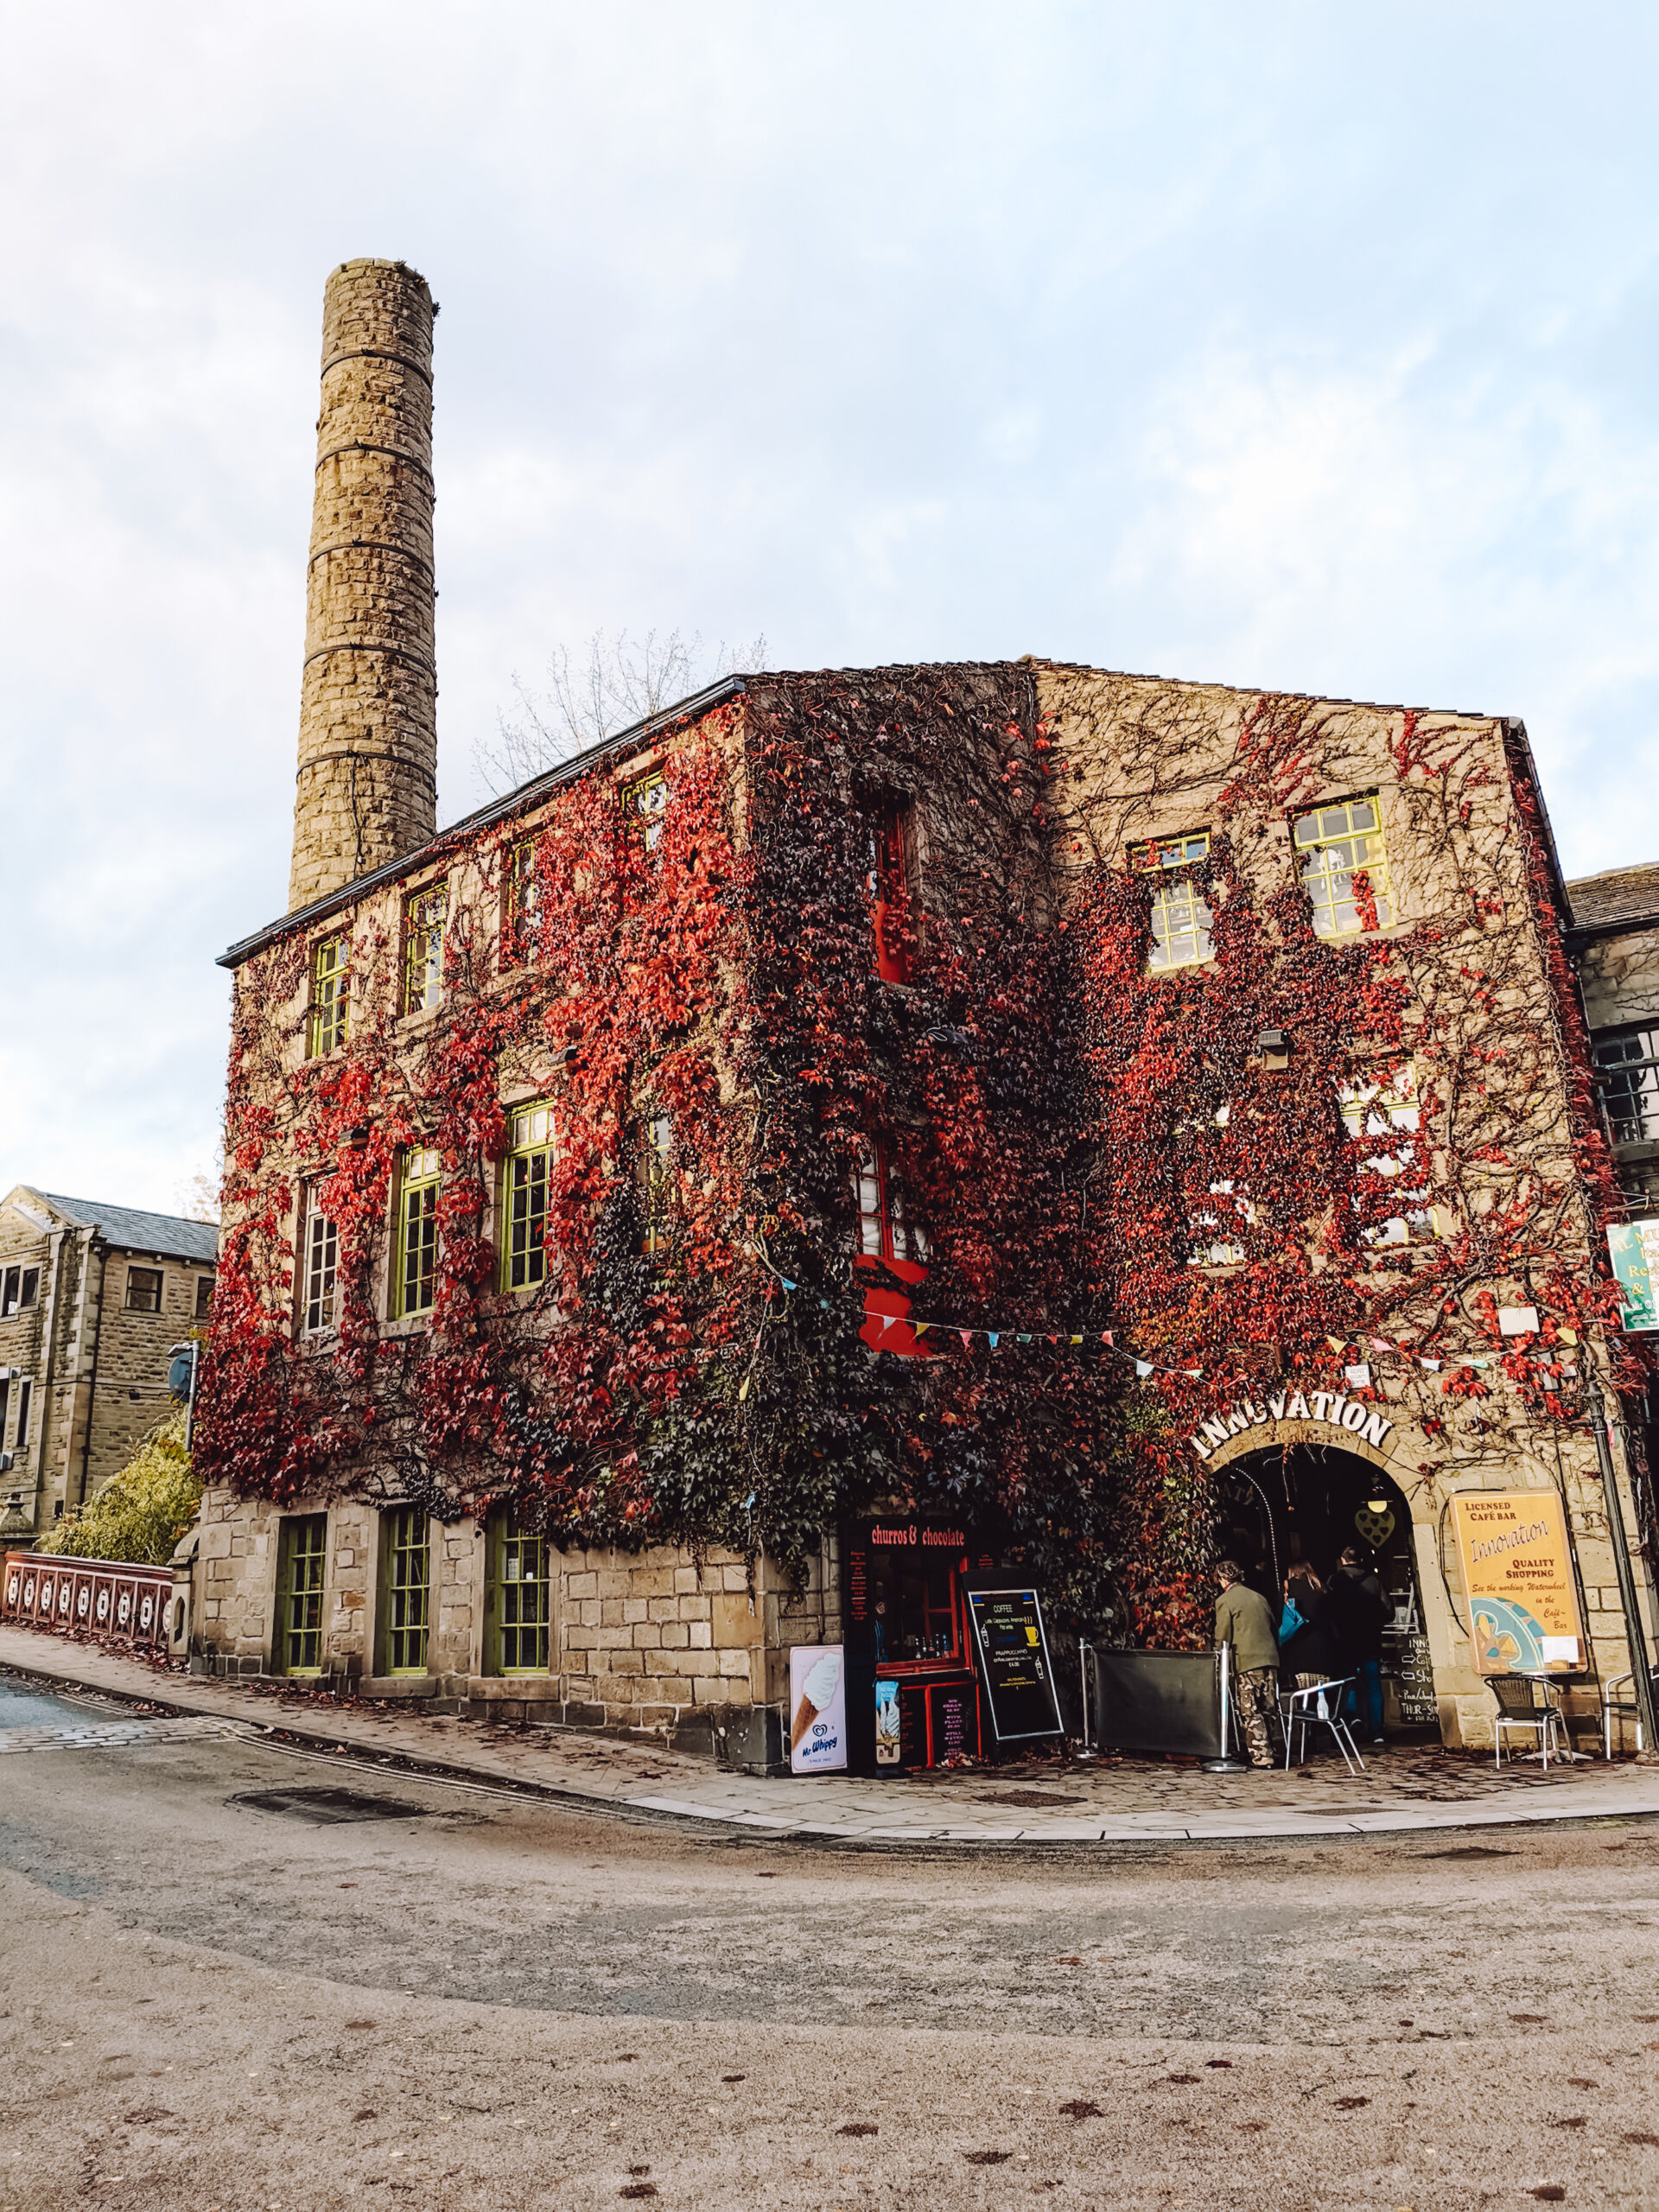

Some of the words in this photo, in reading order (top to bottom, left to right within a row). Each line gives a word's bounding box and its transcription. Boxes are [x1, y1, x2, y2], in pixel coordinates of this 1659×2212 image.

[1189, 1389, 1394, 1459] INNOVATION
[1465, 1502, 1511, 1511] LICENSED
[1470, 1510, 1496, 1521] CAFÉ
[1497, 1512, 1516, 1521] BAR
[872, 1524, 907, 1545] churros
[909, 1524, 917, 1545] &
[922, 1526, 965, 1546] chocolate
[1471, 1520, 1549, 1563] Innovation
[1512, 1559, 1554, 1569] QUALITY
[1506, 1569, 1554, 1579] SHOPPING
[1471, 1584, 1486, 1592] See
[1498, 1583, 1524, 1593] working
[1527, 1582, 1566, 1591] Waterwheel
[1545, 1595, 1555, 1604] the
[993, 1605, 1013, 1613] COFFEE
[1554, 1620, 1567, 1629] Bar
[802, 1747, 811, 1758] Mr.
[812, 1736, 837, 1753] Whippy
